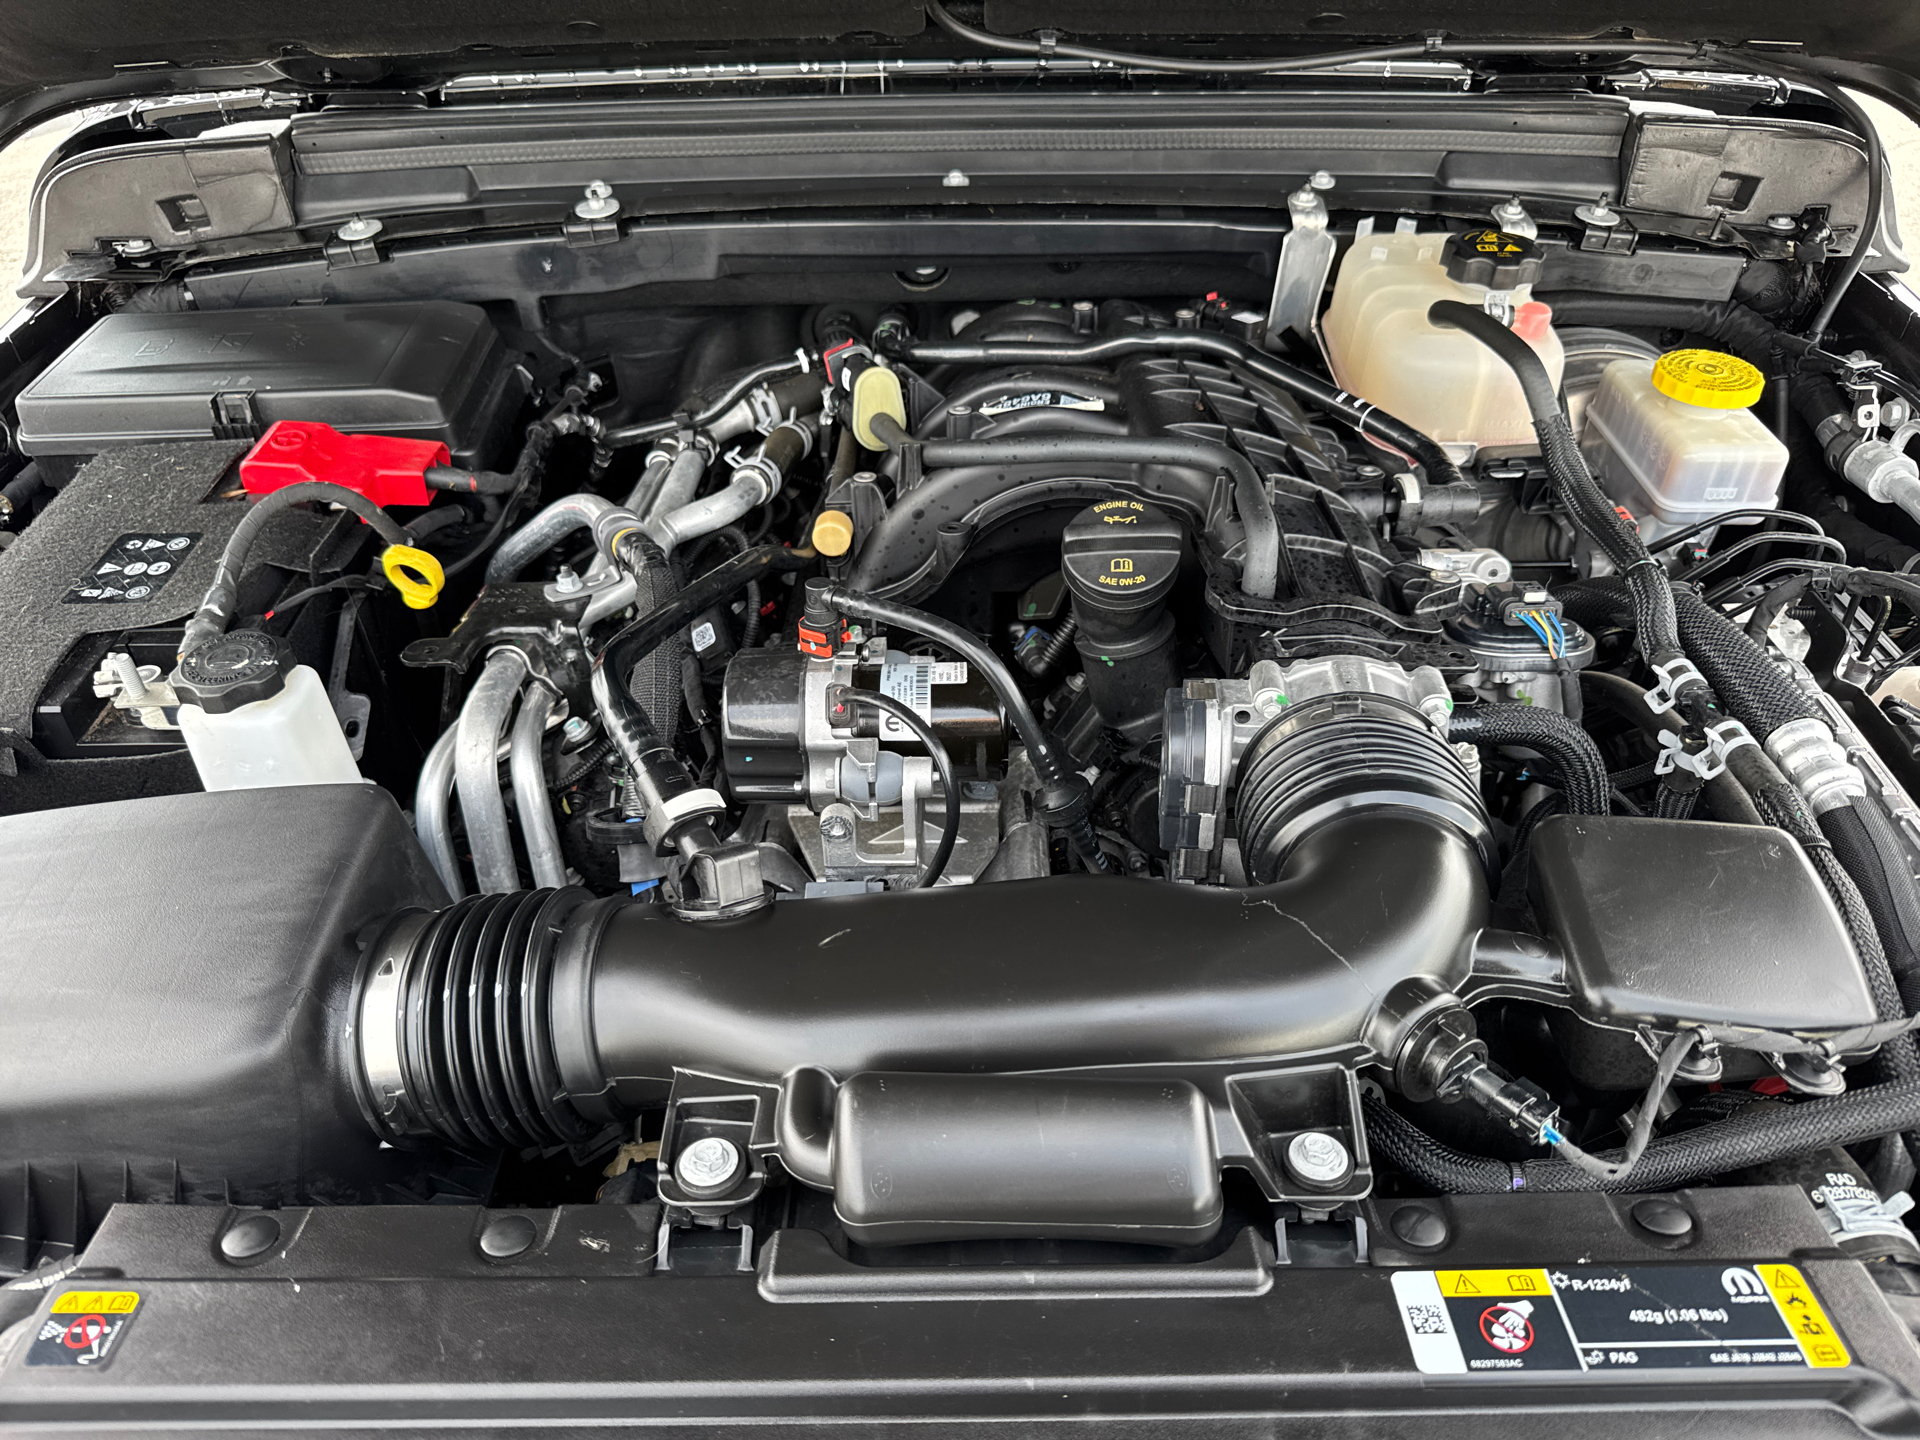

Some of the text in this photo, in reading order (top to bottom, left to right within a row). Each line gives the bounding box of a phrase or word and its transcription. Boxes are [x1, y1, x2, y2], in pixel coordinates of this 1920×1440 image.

[1093, 501, 1144, 513] ENGINE OIL
[1099, 574, 1146, 586] SAE 0W-20
[1825, 1173, 1857, 1186] RAD
[1571, 1278, 1631, 1293] R-1234yf
[1629, 1308, 1728, 1325] 482g (1.06 lbs)
[1609, 1352, 1638, 1364] PAG
